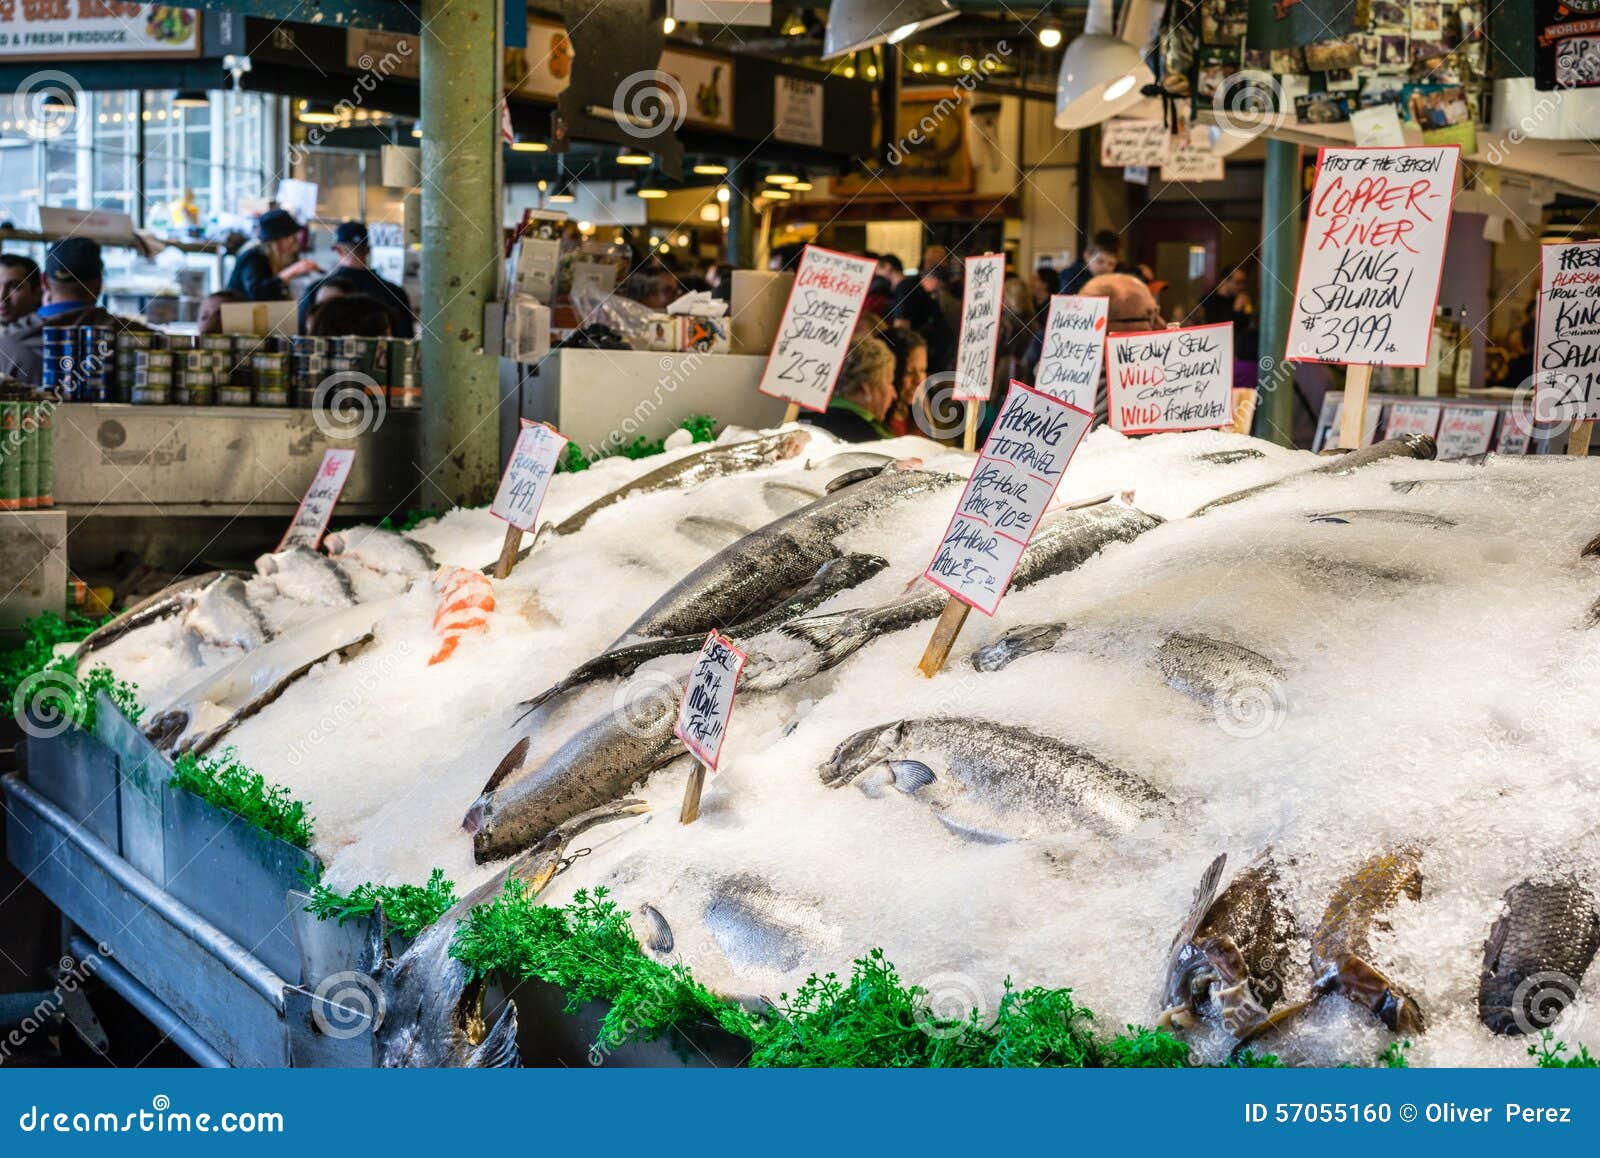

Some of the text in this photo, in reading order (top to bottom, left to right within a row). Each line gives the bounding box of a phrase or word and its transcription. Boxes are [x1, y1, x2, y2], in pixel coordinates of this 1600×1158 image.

[25, 32, 63, 45] FRESH
[67, 30, 126, 44] PRODUCE
[1547, 21, 1587, 35] WORLD
[1558, 40, 1589, 57] ZIP
[1353, 157, 1369, 170] OF
[1372, 155, 1396, 172] THE
[1395, 150, 1444, 173] SEASON
[1300, 268, 1413, 315] SALMON
[1052, 302, 1099, 330] ALASKAN
[784, 316, 848, 348] SALMON
[1043, 333, 1101, 367] SOCKEYE
[1117, 333, 1219, 365] WE ONLY SELL
[1040, 361, 1096, 386] SALMON
[1119, 351, 1222, 389] WILD SALMON
[1137, 380, 1210, 400] CAUGHT BY
[1000, 393, 1068, 446] PACKING
[1121, 392, 1227, 427] WILD FISHERMEN
[964, 488, 994, 518] PACK
[932, 547, 963, 577] PACK
[689, 684, 720, 720] MONK
